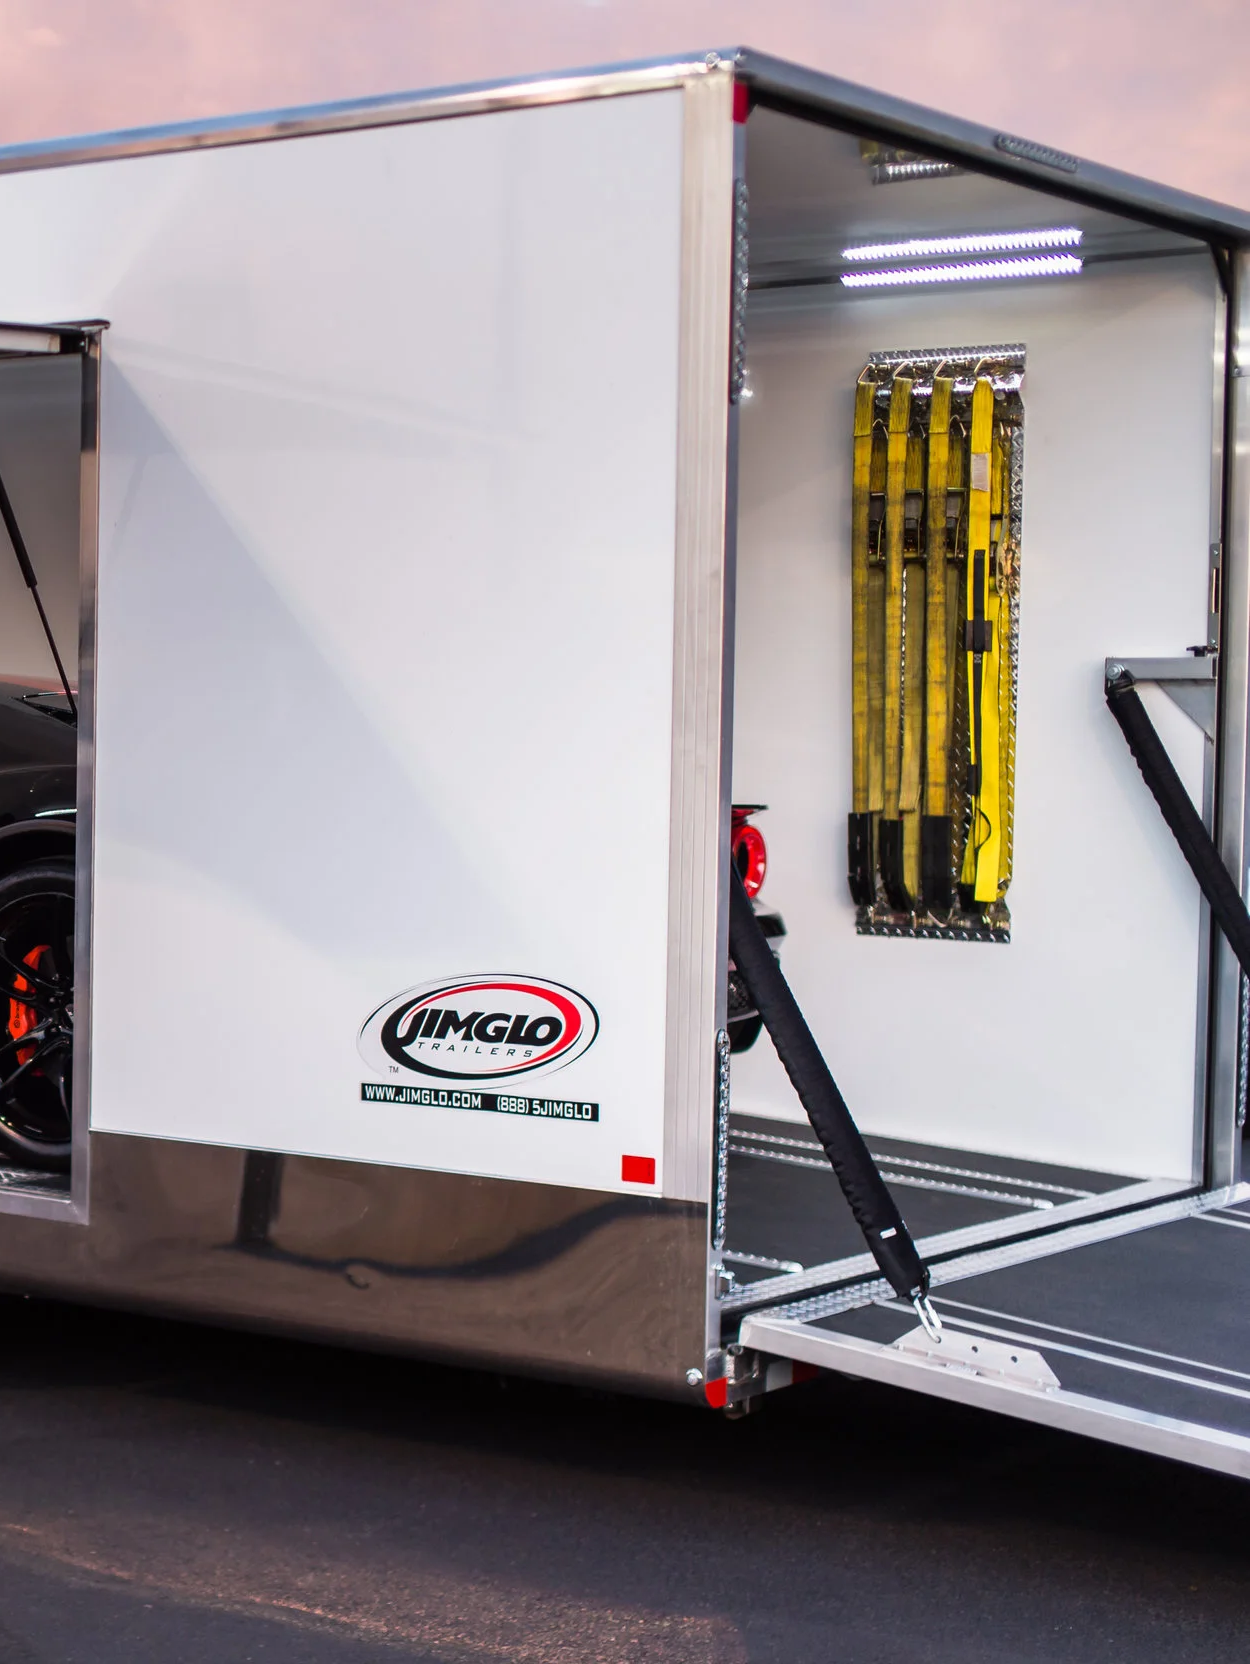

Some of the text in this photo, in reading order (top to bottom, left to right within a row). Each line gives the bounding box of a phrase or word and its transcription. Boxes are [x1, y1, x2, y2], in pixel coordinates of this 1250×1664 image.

[395, 1008, 563, 1047] JIMGLO
[417, 1042, 533, 1058] TRAILERS
[365, 1085, 592, 1119] WWW.JIMGLO.COM (888) 5JIMGLO
